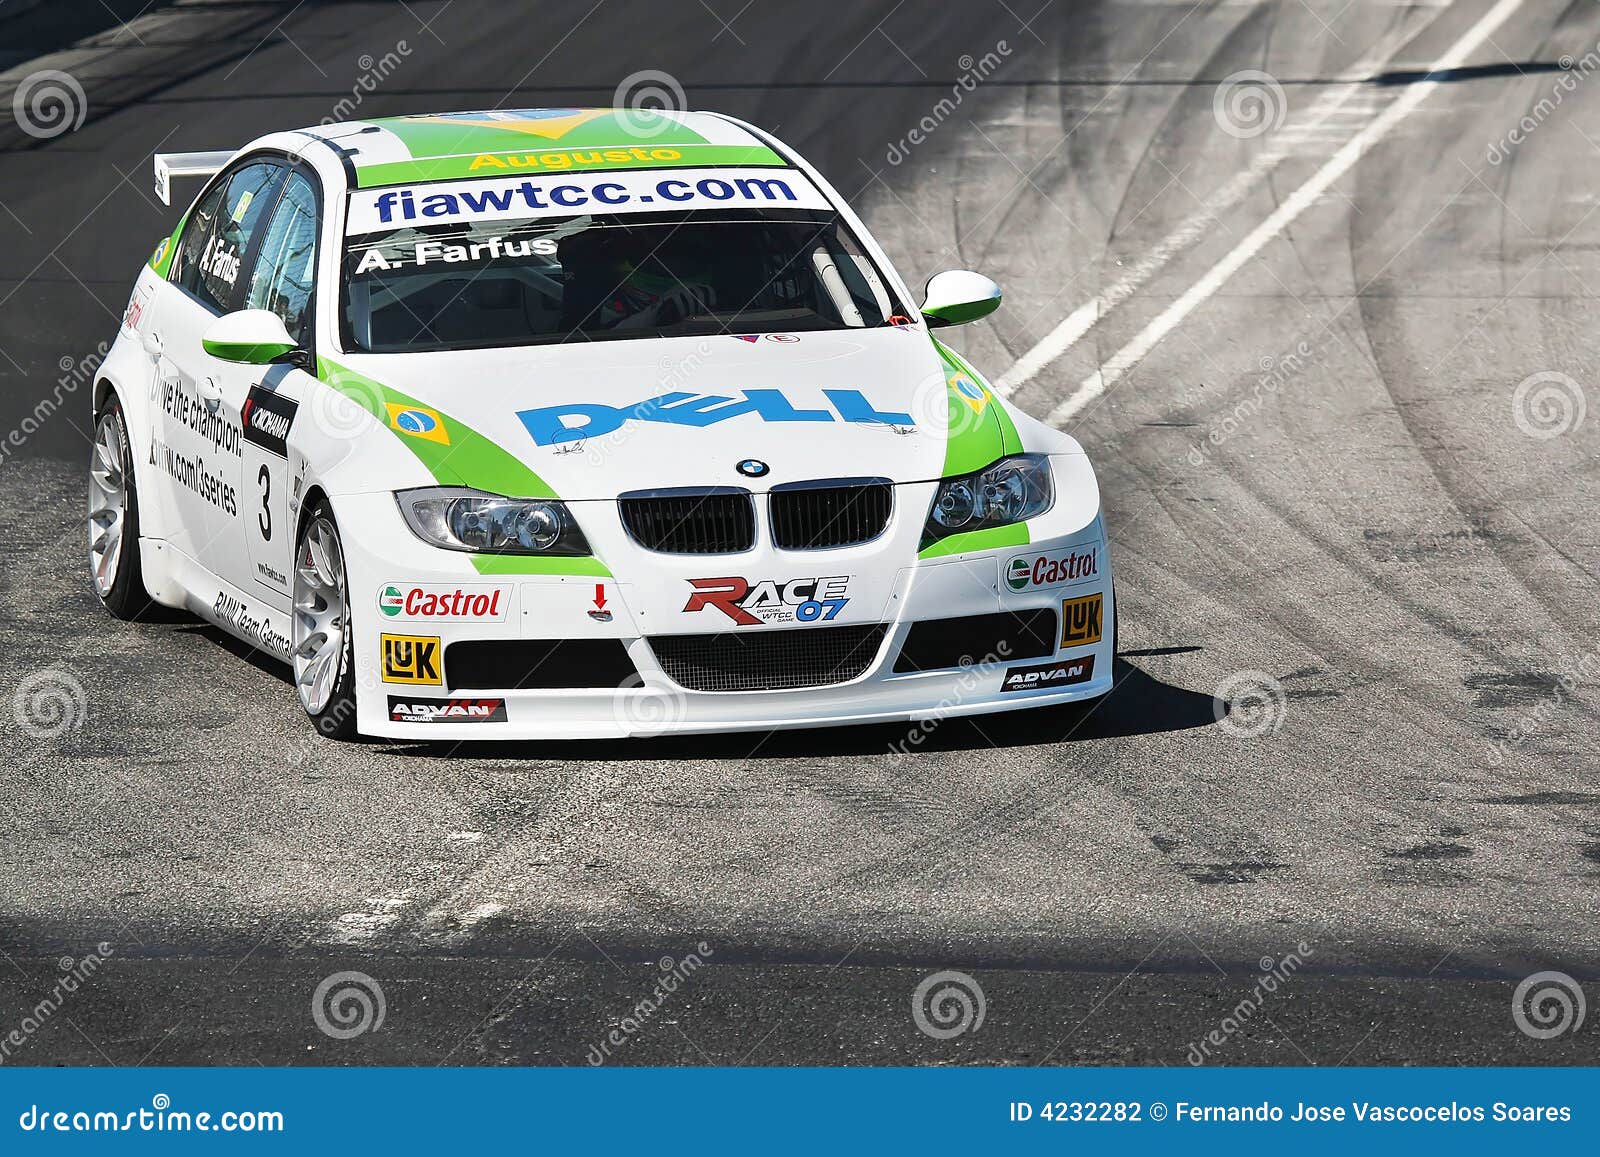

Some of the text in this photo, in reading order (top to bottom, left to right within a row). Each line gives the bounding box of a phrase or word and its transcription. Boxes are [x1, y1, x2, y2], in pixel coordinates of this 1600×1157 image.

[469, 148, 682, 170] Augusto
[374, 178, 797, 223] fiawtcc.com
[355, 237, 558, 274] A. Farfus
[174, 379, 189, 425] the
[515, 388, 916, 447] DELL
[251, 406, 290, 440] YOKOHAMA
[258, 464, 272, 541] 3
[1032, 548, 1097, 585] Castrol
[213, 591, 240, 628] BMW
[237, 604, 260, 640] Team
[405, 588, 501, 616] Castrol
[682, 575, 850, 626] RACE
[762, 612, 793, 620] WTCC
[796, 597, 851, 622] 07
[1007, 665, 1084, 684] ADVAN
[392, 703, 490, 716] ADVAN
